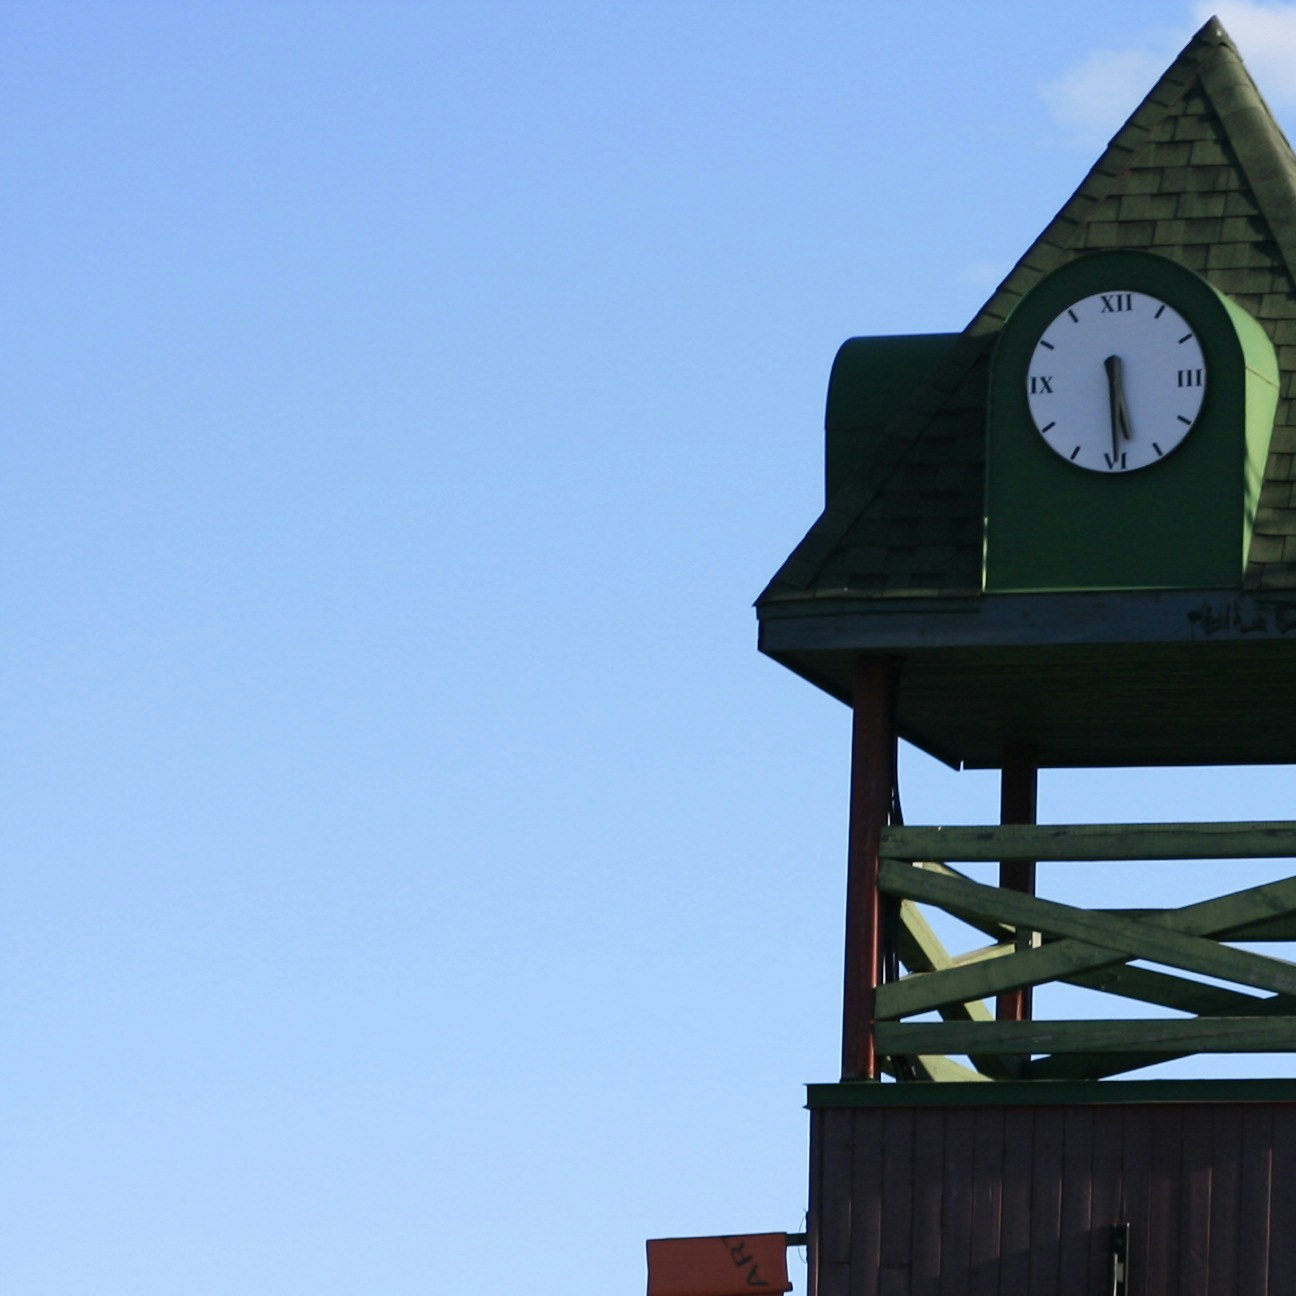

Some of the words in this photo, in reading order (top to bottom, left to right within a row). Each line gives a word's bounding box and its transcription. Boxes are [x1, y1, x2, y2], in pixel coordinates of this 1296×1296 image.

[1101, 294, 1134, 314] XII
[1030, 376, 1054, 394] IX
[1177, 369, 1203, 388] III
[1104, 452, 1128, 470] VI
